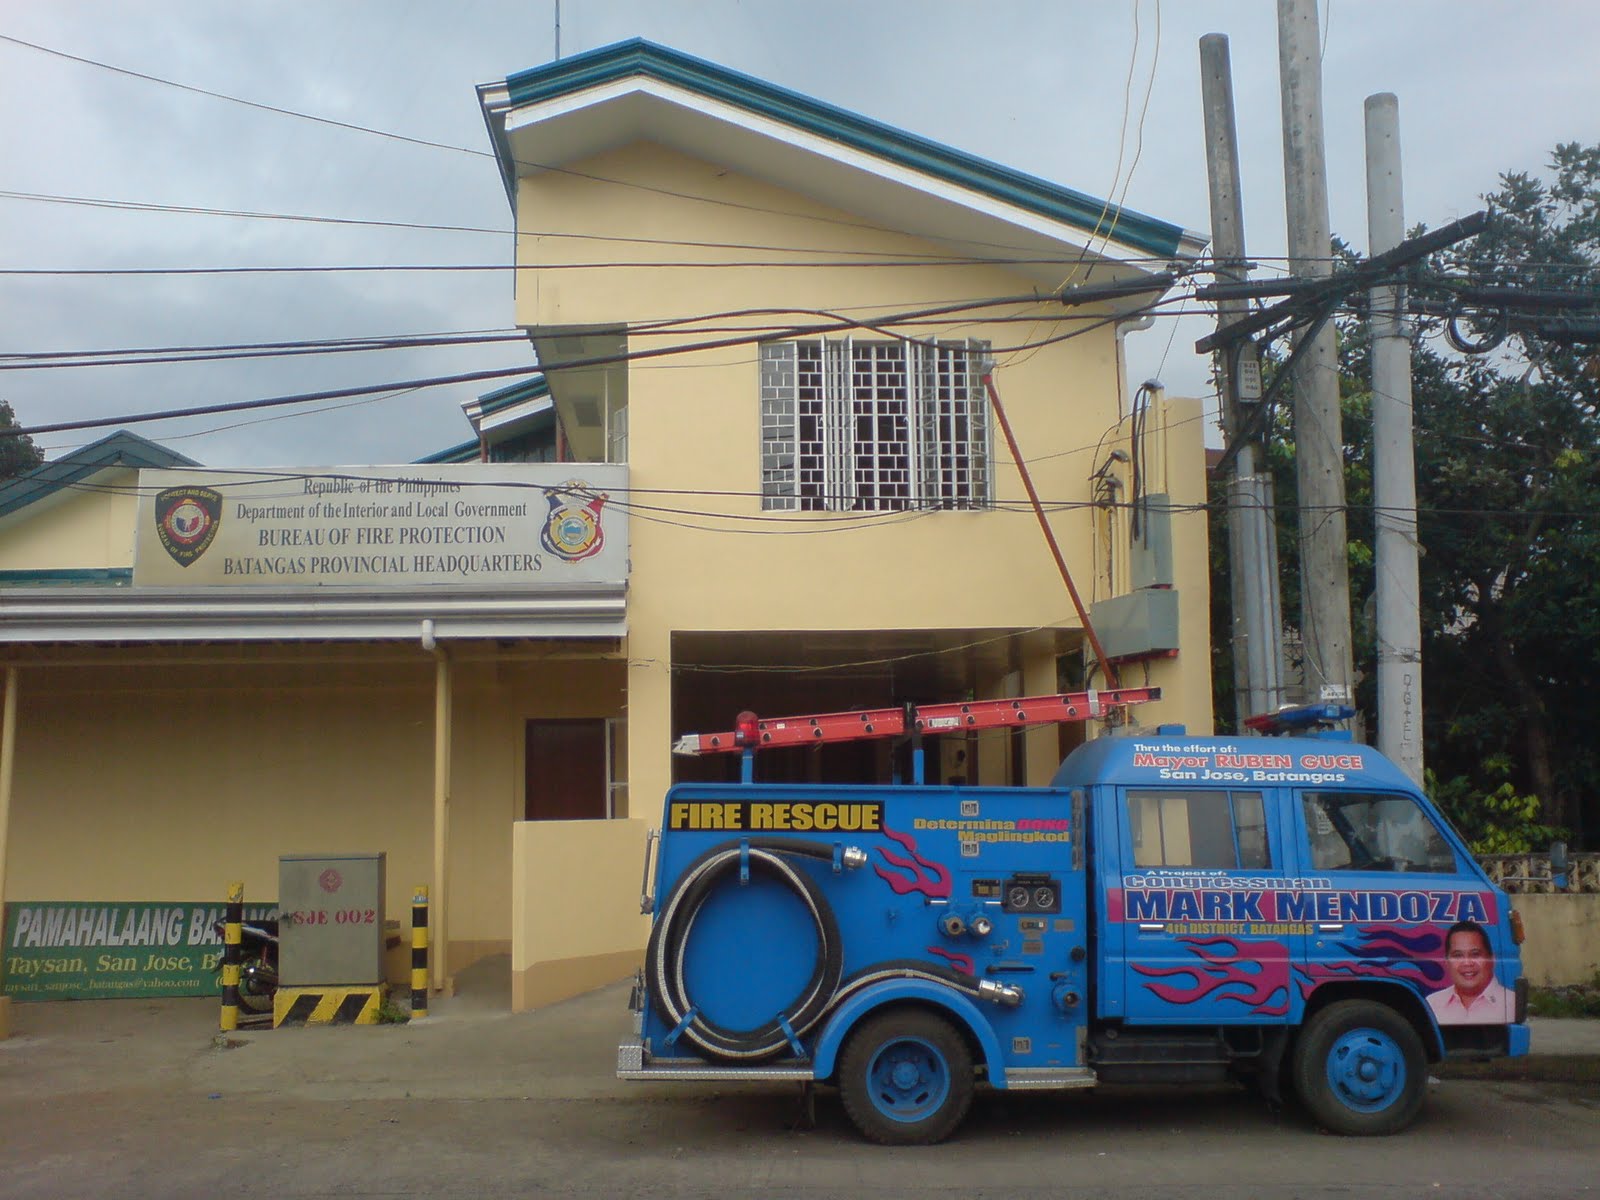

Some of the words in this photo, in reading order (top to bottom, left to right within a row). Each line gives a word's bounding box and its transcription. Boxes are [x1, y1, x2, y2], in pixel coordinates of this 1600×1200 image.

[303, 475, 354, 498] Republic
[359, 479, 371, 494] of
[375, 478, 393, 494] the
[397, 477, 461, 498] Philippines
[237, 503, 305, 524] Department
[308, 503, 321, 518] of
[323, 503, 342, 518] the
[343, 502, 389, 518] Interior
[391, 501, 412, 517] and
[416, 502, 449, 518] Local
[454, 501, 527, 518] Government
[258, 528, 325, 546] BUREAU
[328, 528, 351, 545] OF
[357, 527, 394, 545] FIRE
[399, 526, 506, 545] PROTECTION
[223, 557, 306, 575] BATANGAS
[311, 555, 409, 574] PROVINCIAL
[413, 554, 543, 576] HEADQUARTERS
[1133, 744, 1160, 753] Thru
[1161, 744, 1181, 753] the
[1183, 744, 1217, 754] effort
[1219, 745, 1238, 754] of:
[1133, 753, 1208, 770] Mayor
[1215, 754, 1292, 769] RUBEN
[1301, 755, 1363, 770] GUCE
[1159, 769, 1197, 780] San
[1201, 769, 1250, 783] Jose,
[1252, 770, 1346, 783] Batangas
[671, 803, 742, 829] FIRE
[750, 803, 880, 831] RESCUE
[957, 830, 1070, 843] Maglingkod
[1123, 874, 1332, 891] Congressman
[1124, 889, 1266, 922] MARK
[1274, 890, 1489, 923] MENDOZA
[292, 910, 329, 926] SJE
[335, 909, 375, 925] 002
[12, 907, 184, 948] PAMAHALAANG
[1166, 923, 1187, 934] 4th
[1250, 923, 1314, 935] BATANGAS
[95, 954, 138, 973] San
[143, 954, 193, 972] Jose,
